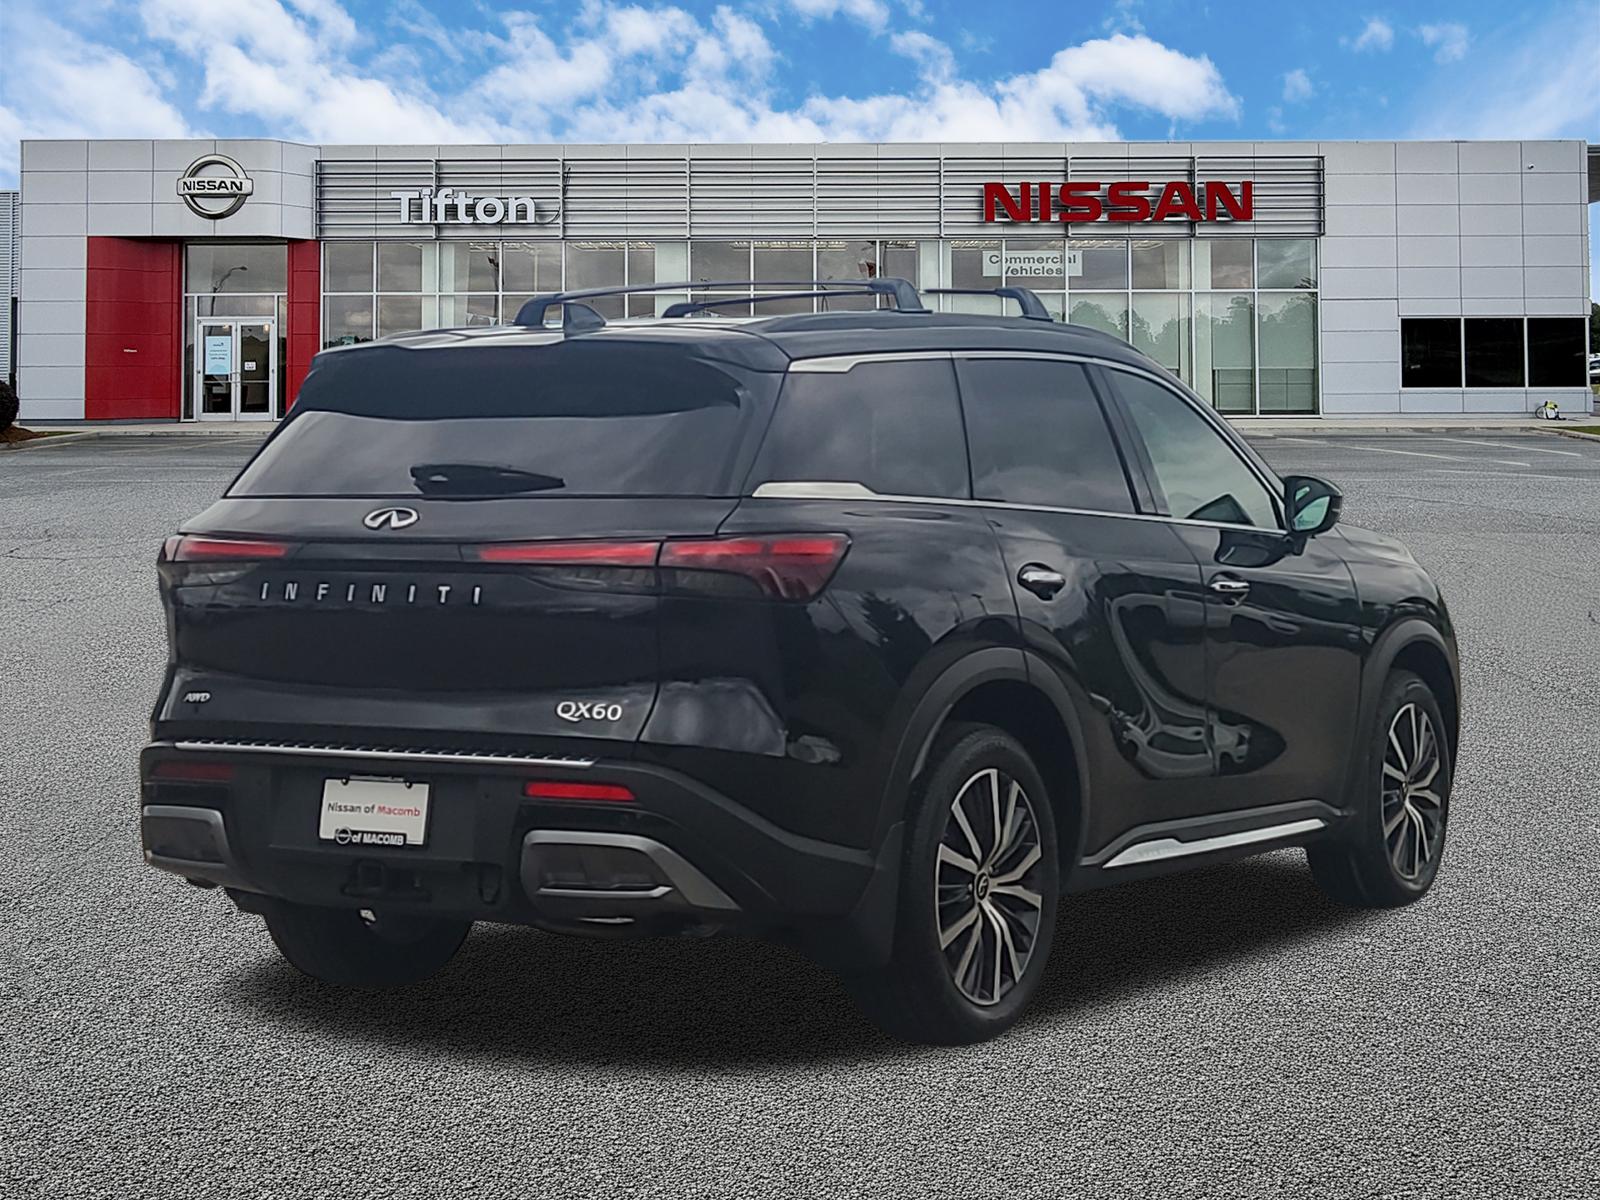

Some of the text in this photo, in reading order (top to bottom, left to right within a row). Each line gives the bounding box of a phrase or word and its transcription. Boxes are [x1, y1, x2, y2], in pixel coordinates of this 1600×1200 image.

[182, 180, 243, 192] NISSAN
[391, 187, 536, 224] Tifton
[983, 181, 1254, 222] NISSAN
[261, 582, 481, 604] INFINITI
[183, 692, 210, 702] AWD
[556, 701, 622, 722] QX60
[327, 802, 421, 816] Nissan of Macomb
[351, 833, 361, 843] of
[362, 833, 404, 845] MACOMB
